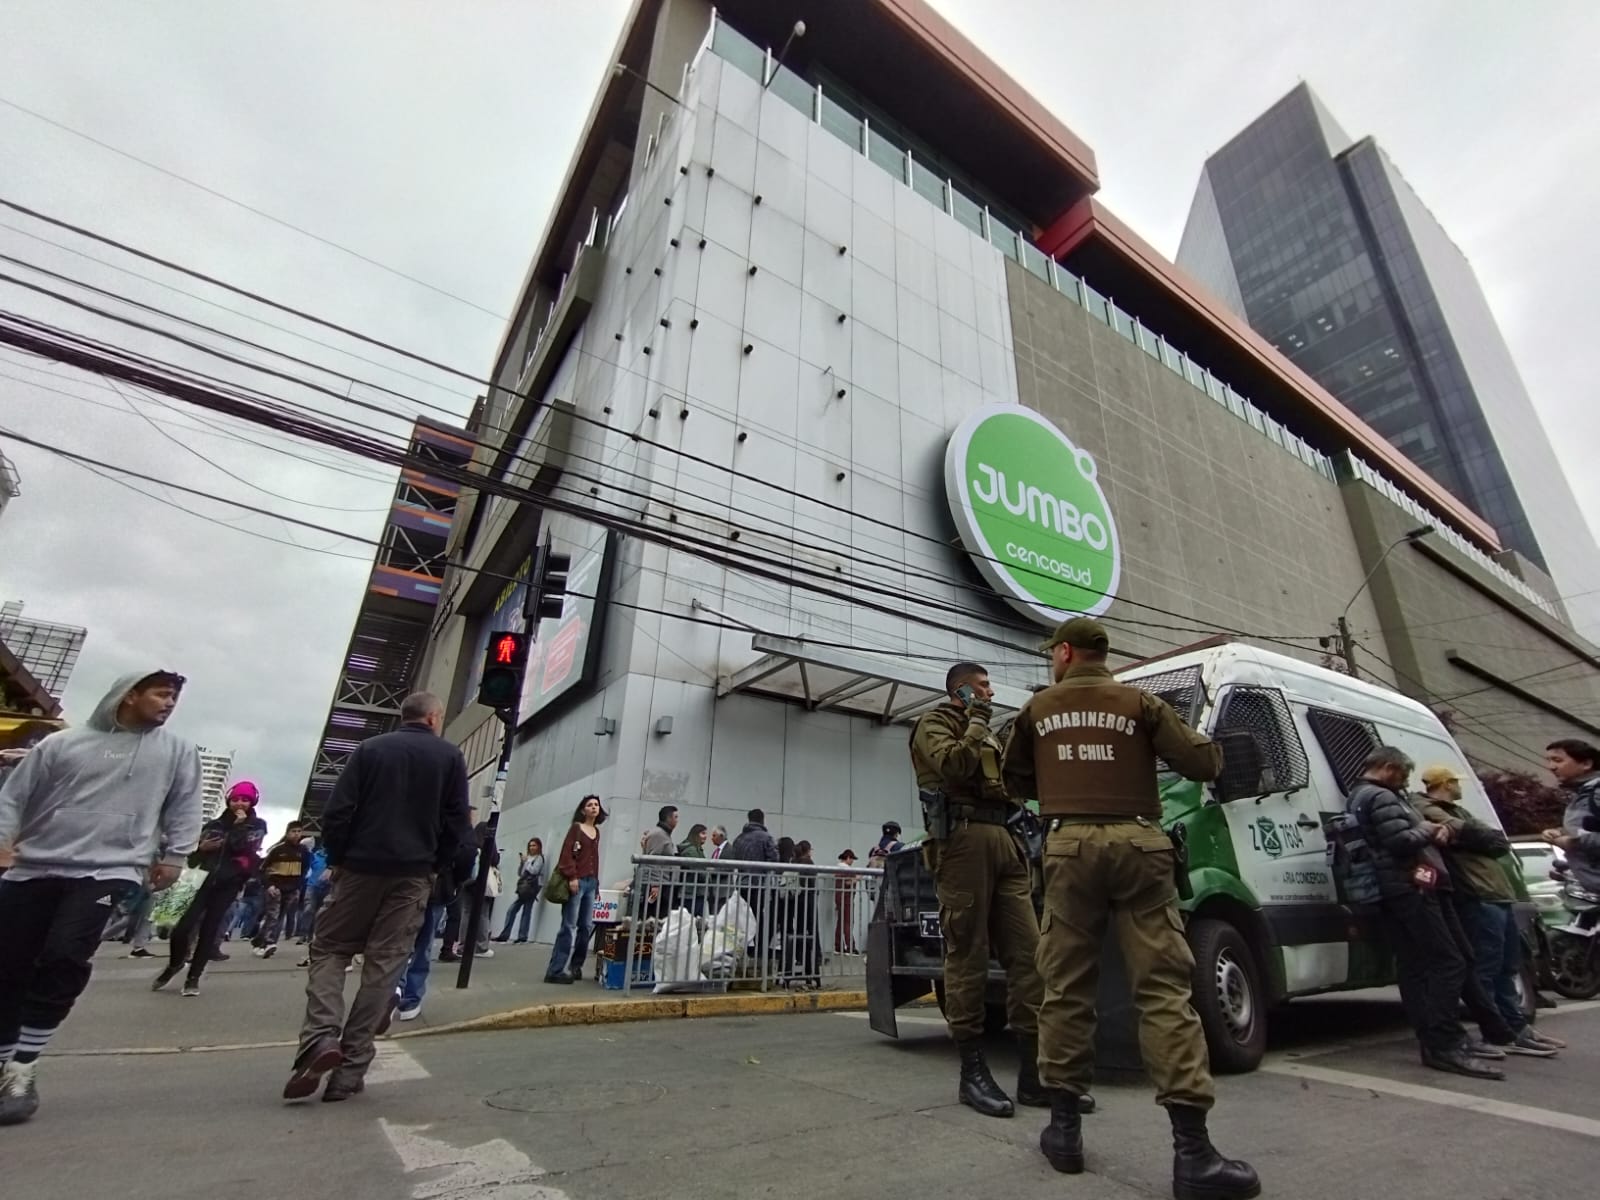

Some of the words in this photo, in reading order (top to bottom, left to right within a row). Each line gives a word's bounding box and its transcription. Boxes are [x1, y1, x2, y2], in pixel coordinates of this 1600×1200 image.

[973, 463, 1108, 551] JUMBO
[1006, 542, 1092, 586] cencosud
[1035, 711, 1137, 737] CARABINEROS
[1057, 744, 1074, 761] DE
[1078, 744, 1116, 761] CHILE
